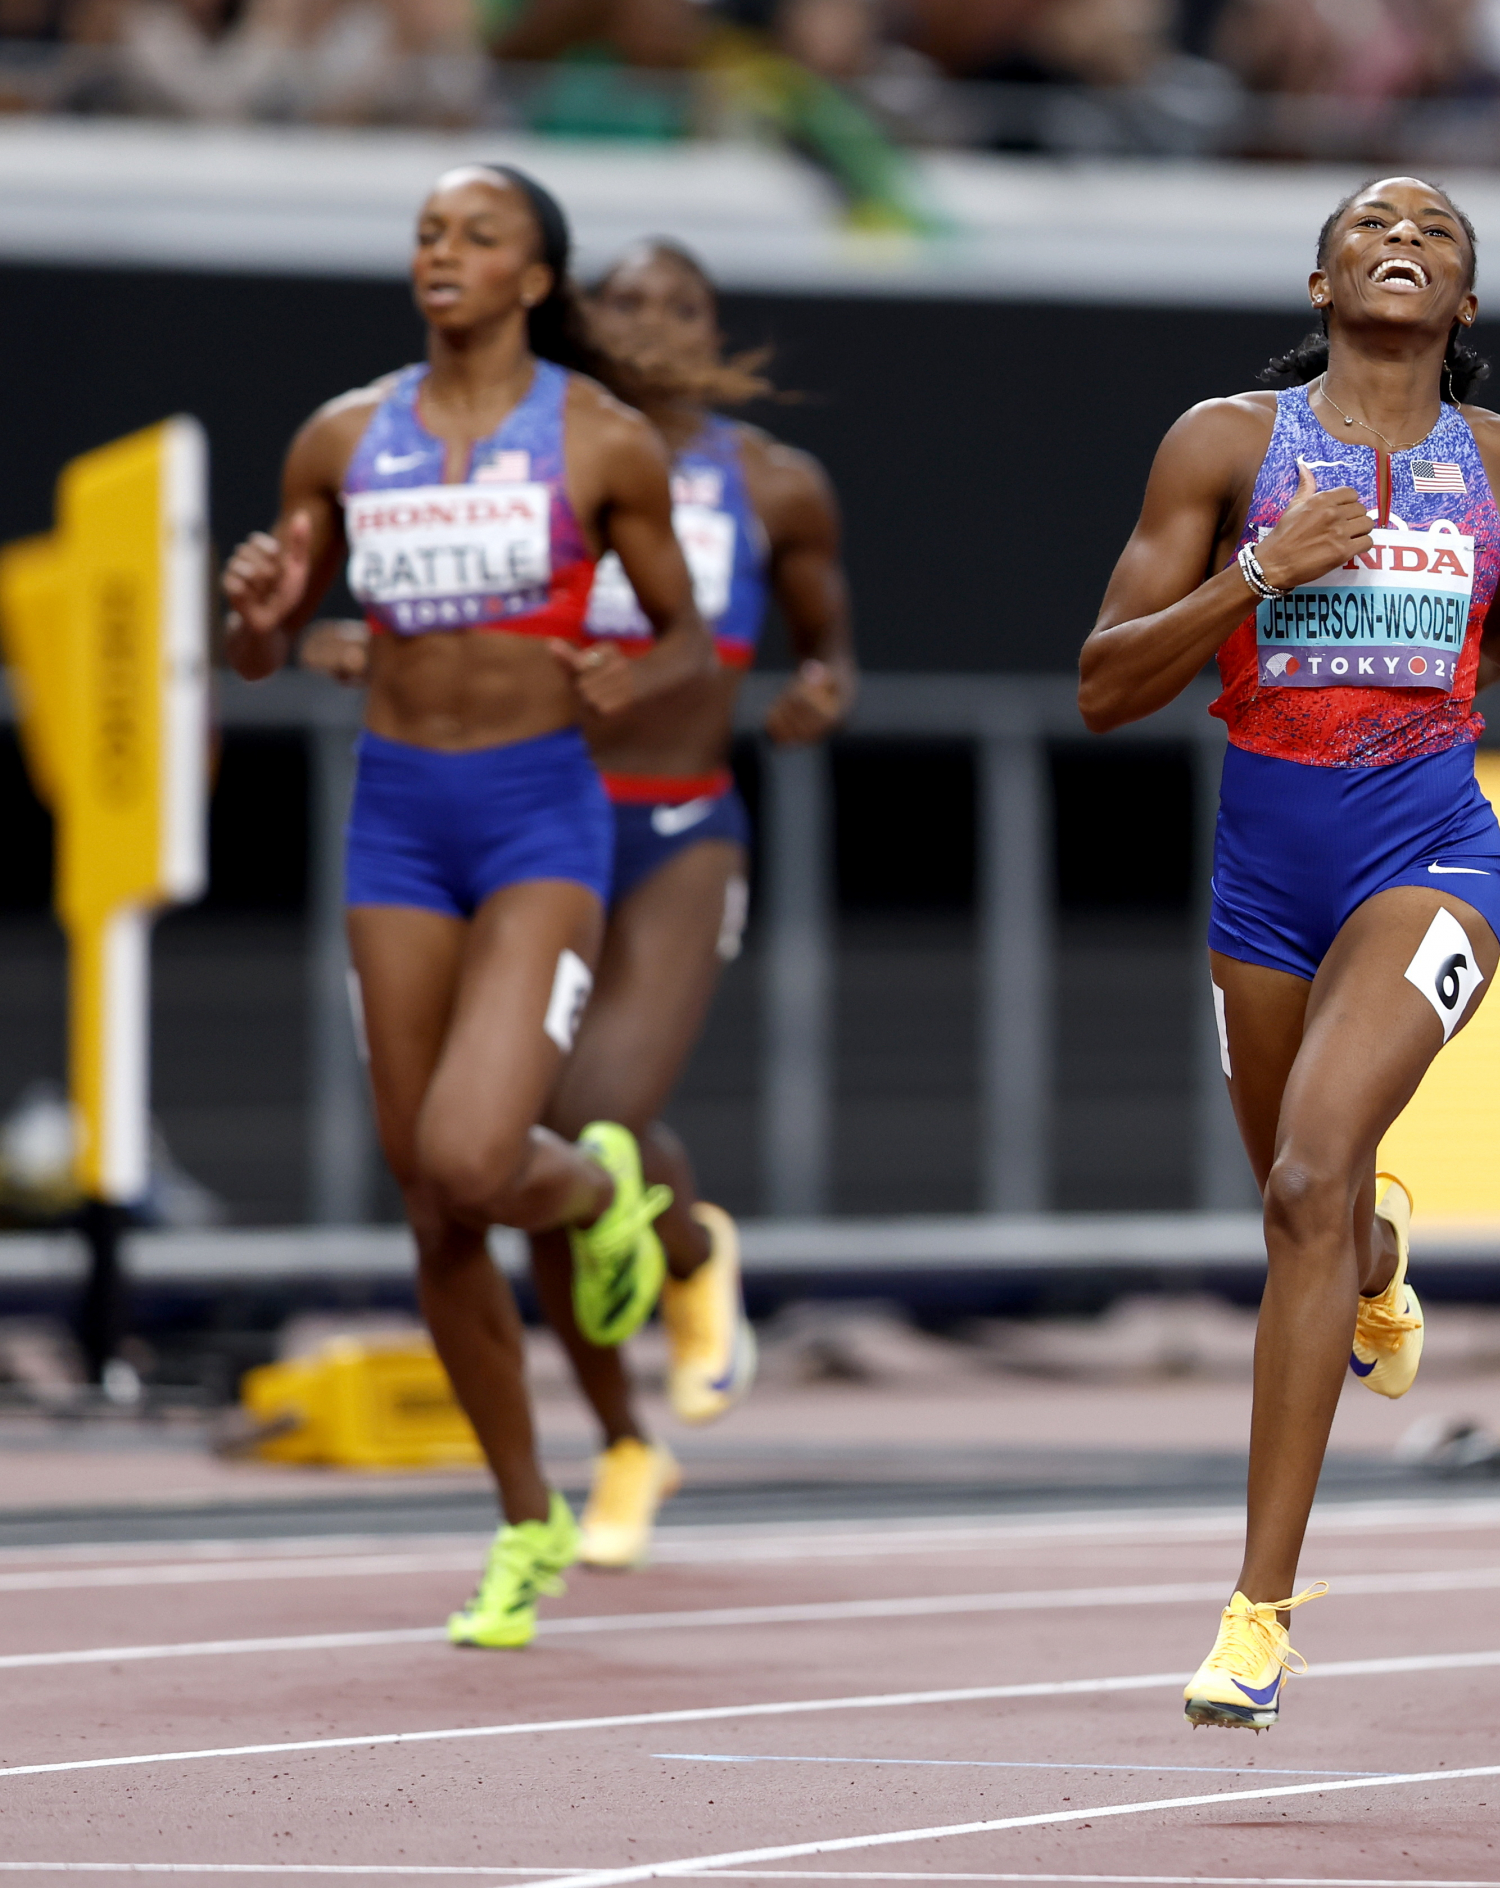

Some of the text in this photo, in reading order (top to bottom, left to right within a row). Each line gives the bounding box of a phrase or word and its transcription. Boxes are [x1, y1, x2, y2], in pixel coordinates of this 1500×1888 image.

[363, 540, 532, 591] BATTLE
[1343, 544, 1469, 578] NDA
[1263, 592, 1465, 646] JEFFERSON-WOODEN
[1434, 953, 1468, 1010] 6
